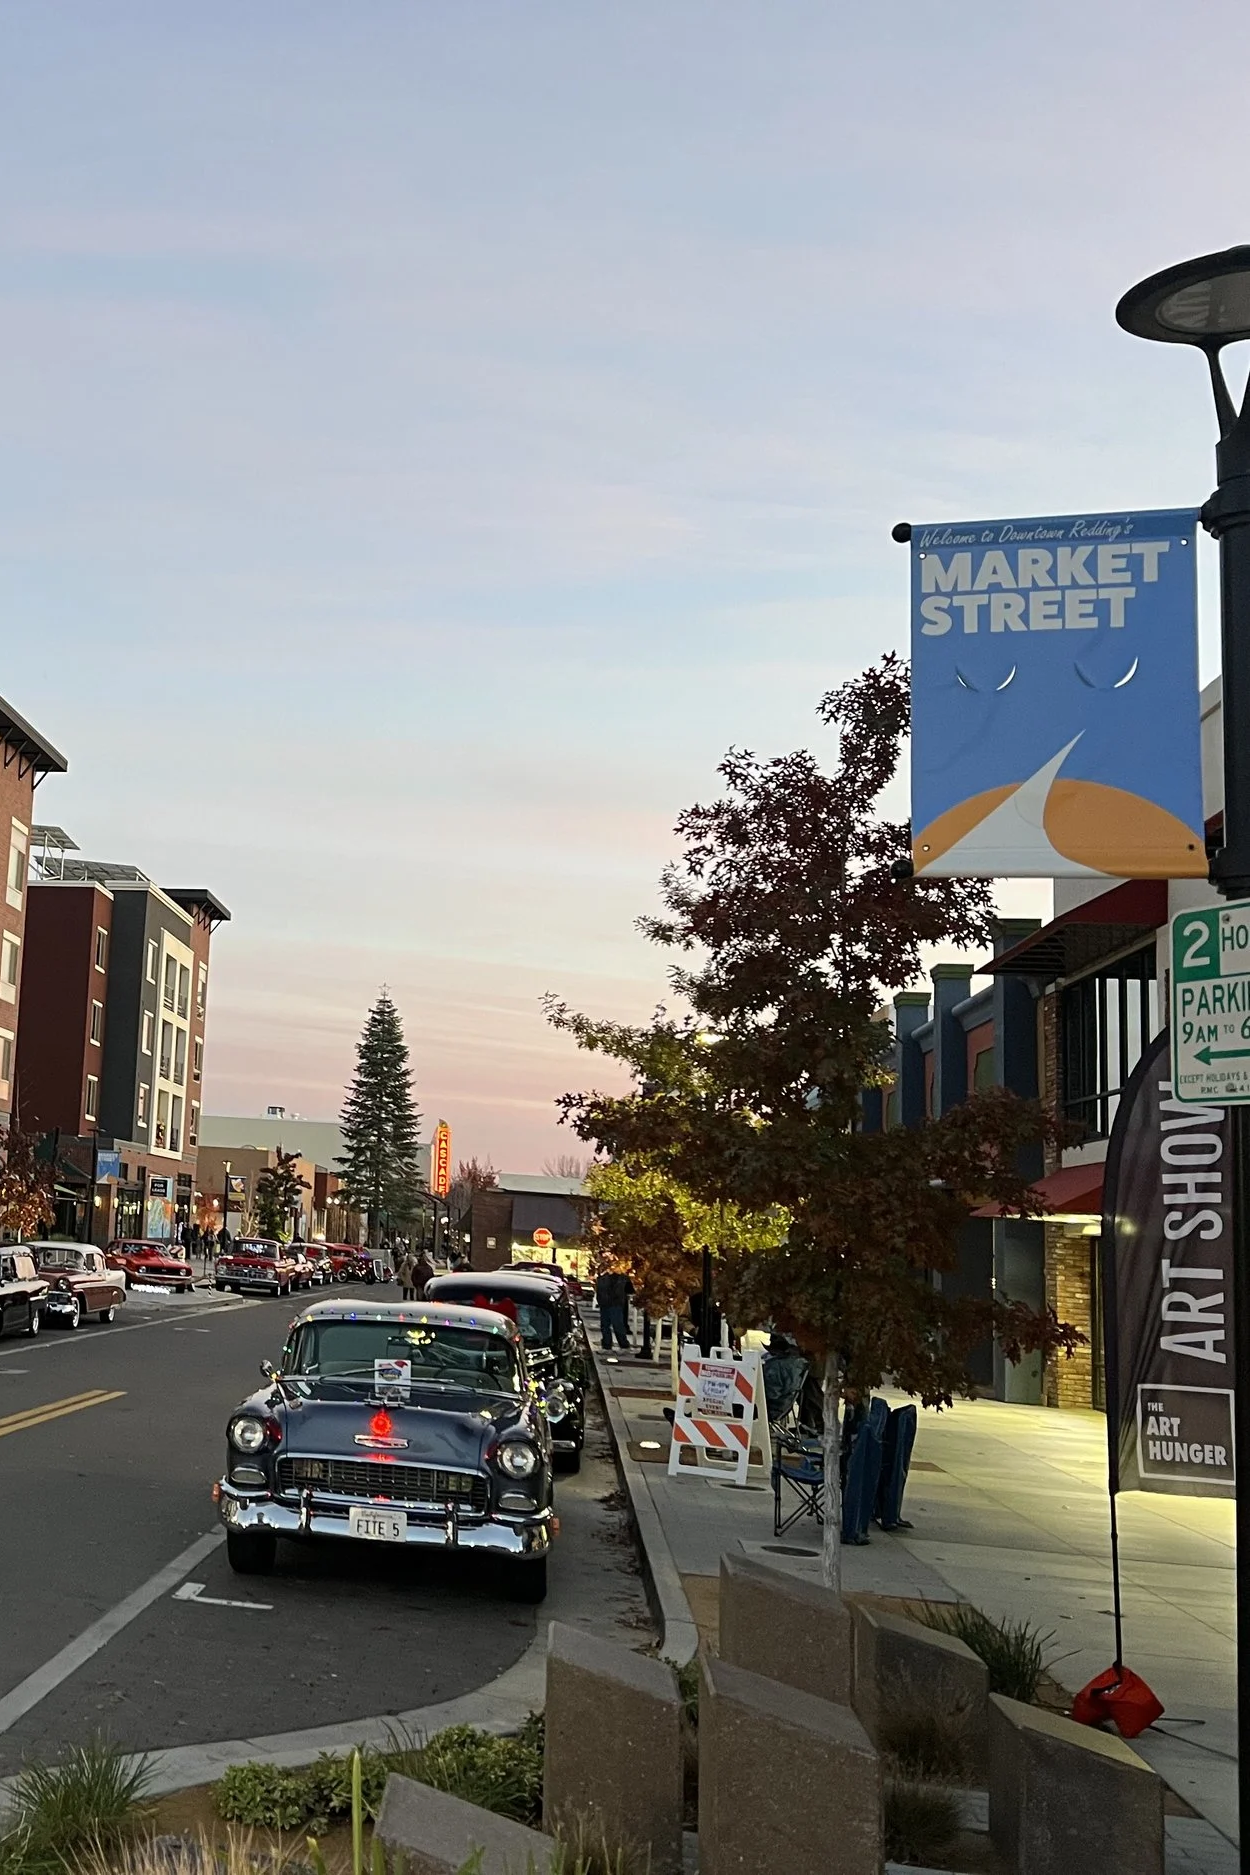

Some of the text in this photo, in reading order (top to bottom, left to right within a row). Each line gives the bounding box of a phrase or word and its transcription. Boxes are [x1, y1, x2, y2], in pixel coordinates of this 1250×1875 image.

[920, 516, 1134, 548] Welcome to Downtown Redding's
[921, 541, 1171, 594] MARKET
[920, 586, 1136, 636] STREET
[1182, 920, 1211, 968] 2
[1182, 980, 1250, 1018] PARKI
[1223, 1024, 1235, 1034] TO
[1180, 1073, 1204, 1084] EXCEPT
[1206, 1071, 1240, 1082] HOLIDAYS
[438, 1131, 448, 1193] CASCADE
[535, 1233, 551, 1242] STOP
[1159, 1258, 1227, 1364] ART
[1147, 1402, 1164, 1412] THE
[1146, 1415, 1181, 1437] ART
[1148, 1440, 1227, 1466] HUNGER
[357, 1519, 400, 1537] FITE 5
